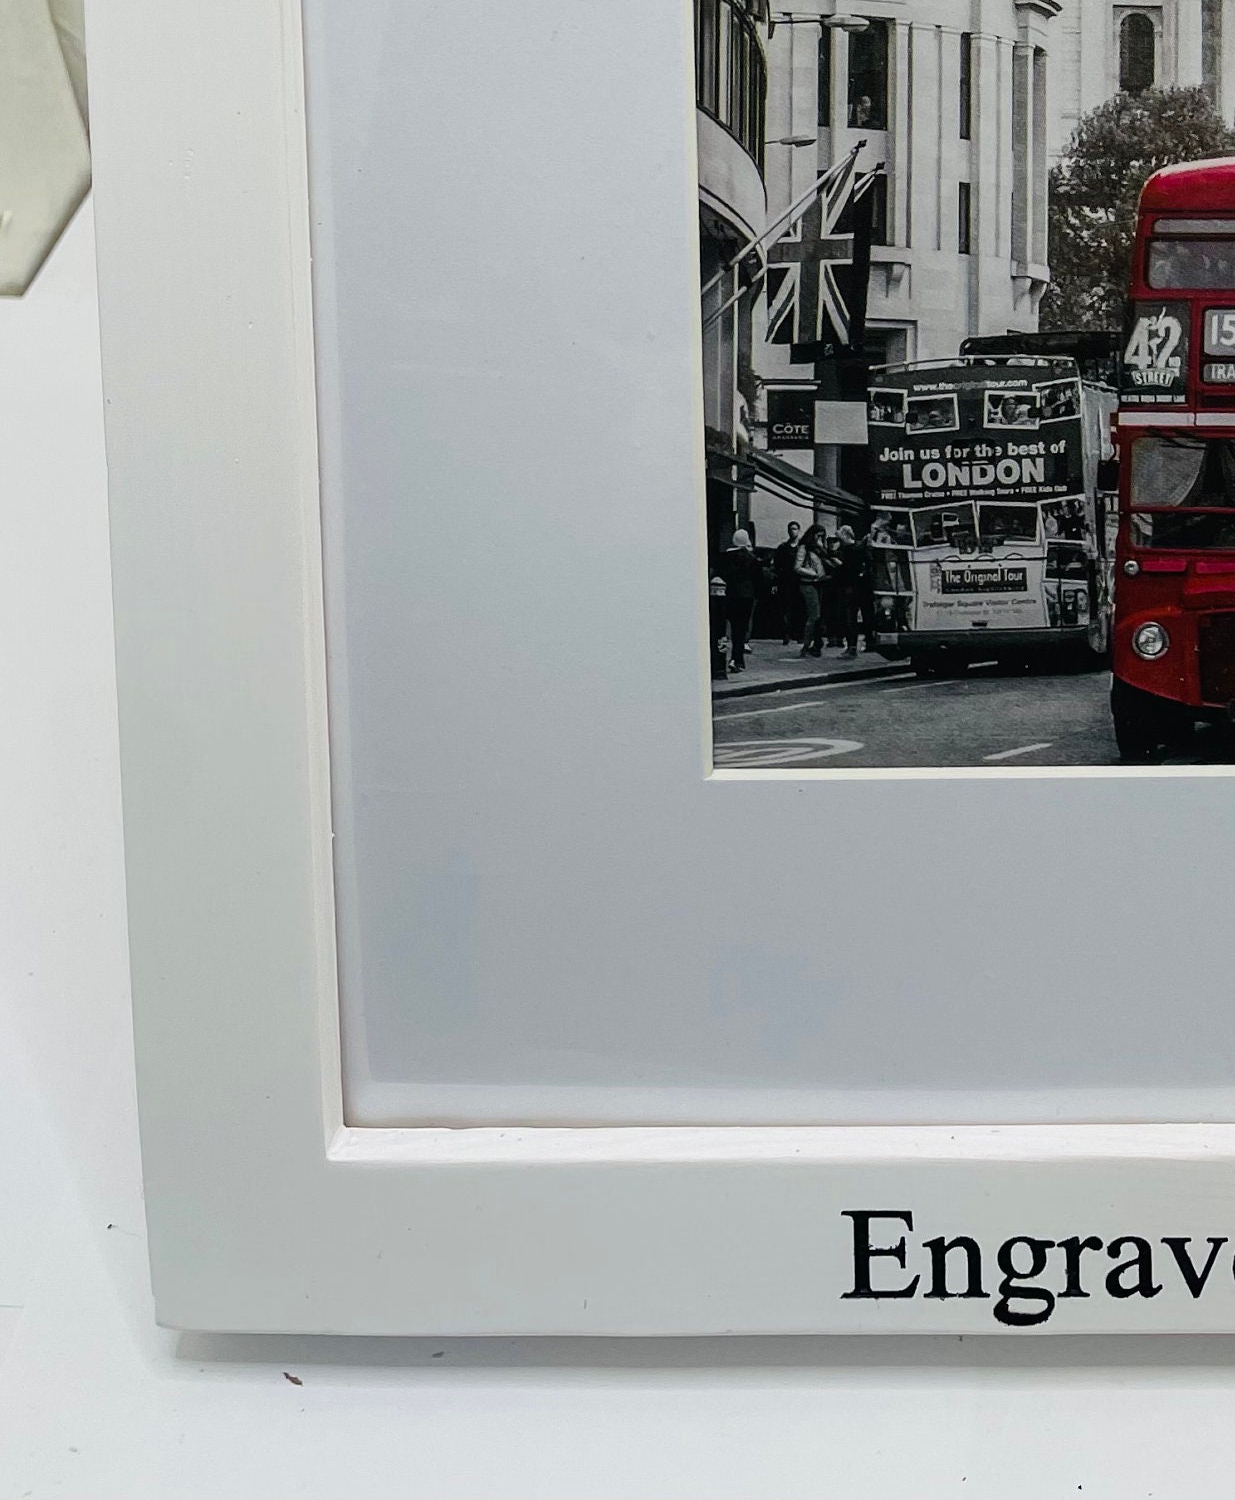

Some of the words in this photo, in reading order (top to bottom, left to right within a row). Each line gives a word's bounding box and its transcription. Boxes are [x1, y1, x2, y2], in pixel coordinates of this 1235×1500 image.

[1134, 370, 1173, 386] STREET
[879, 447, 915, 462] Join
[919, 447, 941, 460] us
[945, 444, 970, 459] for
[974, 443, 1003, 458] the
[1007, 441, 1047, 456] best
[1050, 439, 1067, 454] of
[902, 457, 1046, 489] LONDON
[945, 570, 961, 583] The
[963, 568, 1002, 586] Original
[1003, 568, 1023, 581] Tour
